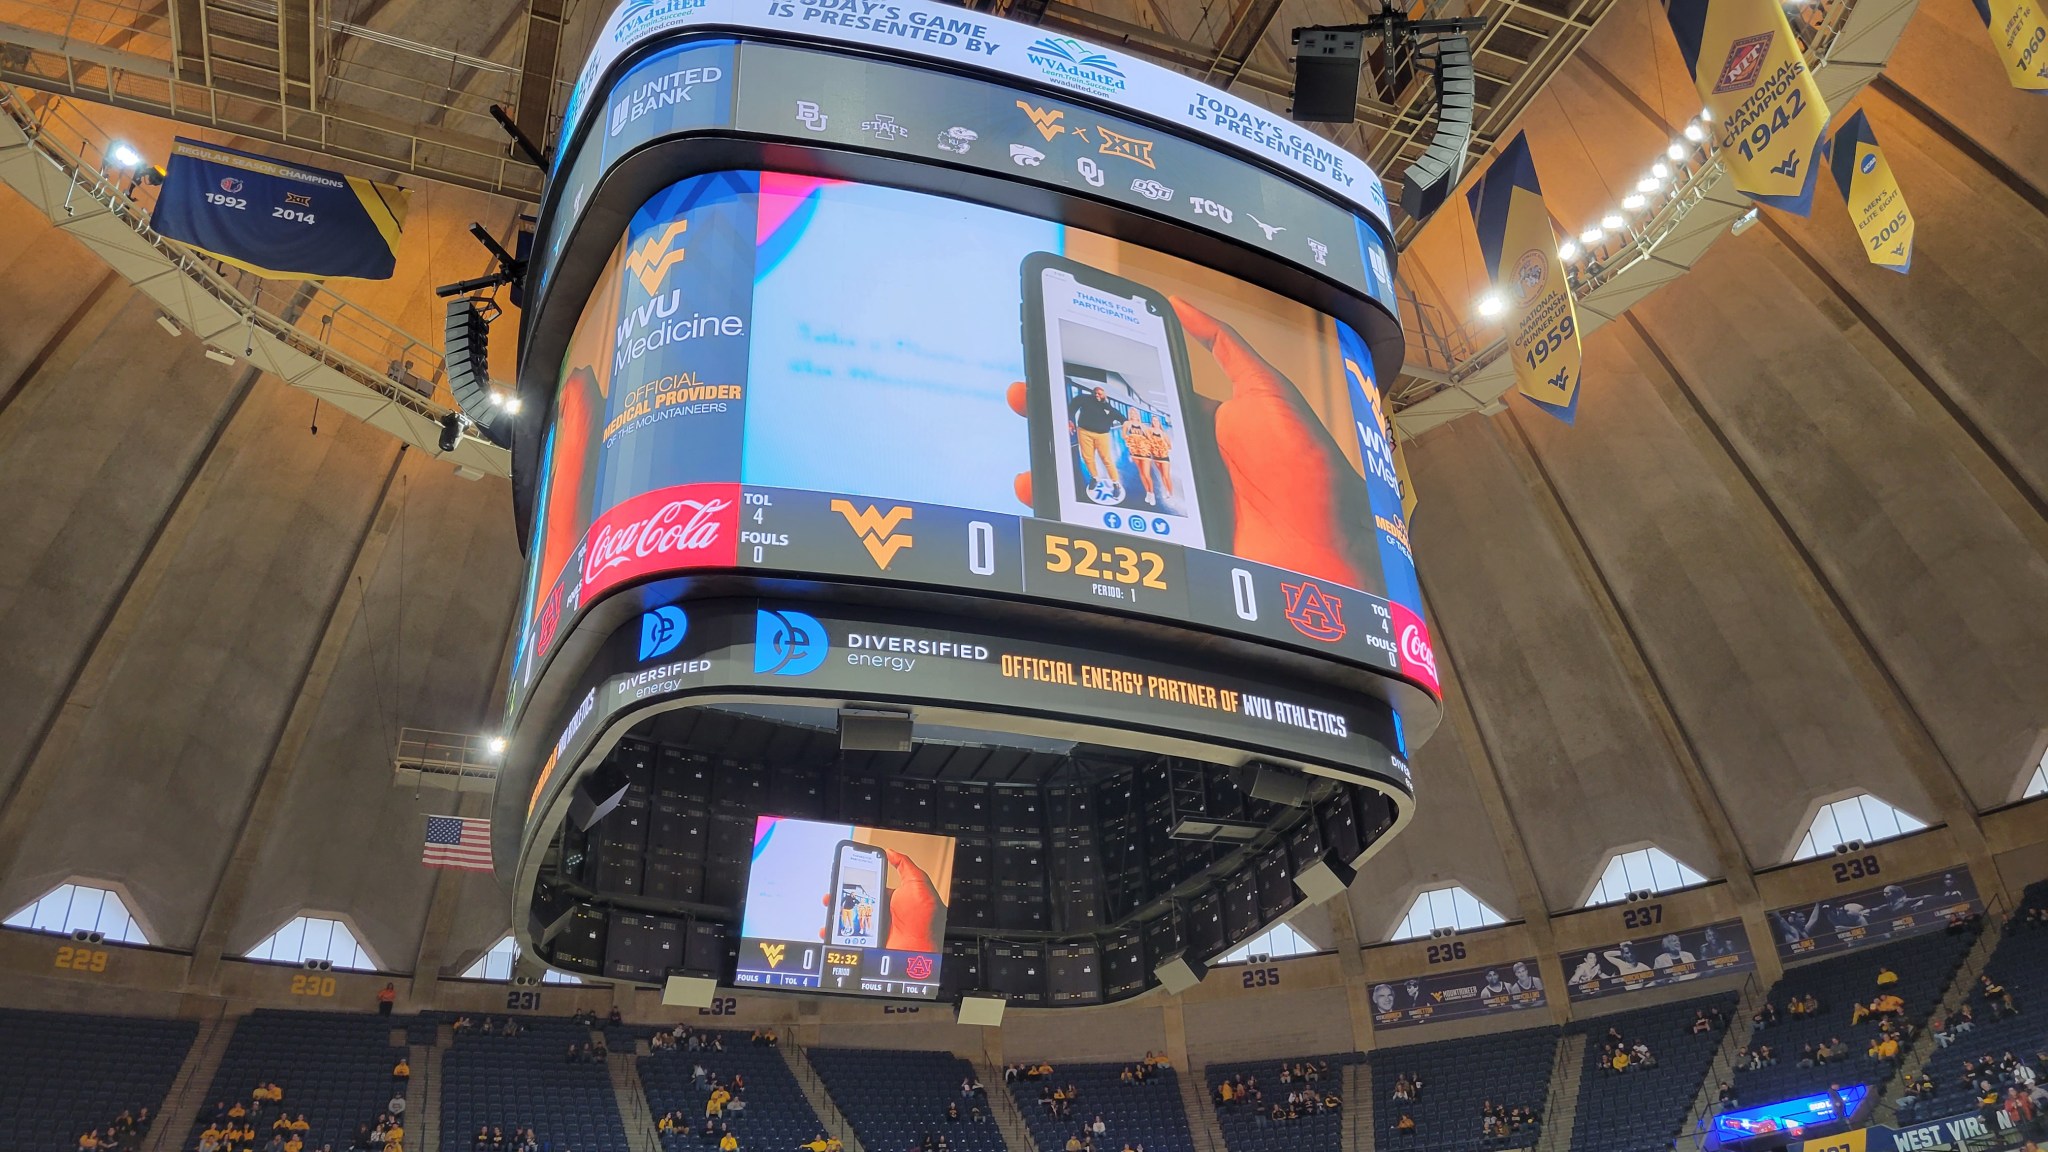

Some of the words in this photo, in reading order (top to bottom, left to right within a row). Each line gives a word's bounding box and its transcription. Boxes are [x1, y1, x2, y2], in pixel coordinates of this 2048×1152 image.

[768, 2, 795, 18] IS
[803, 7, 957, 46] PRESENTED
[966, 39, 999, 56] BY
[908, 12, 987, 39] GAME
[2016, 27, 2046, 71] 1960
[1027, 53, 1125, 90] WVAdultEd
[633, 67, 722, 104] UNITED
[1050, 77, 1109, 98] wvadulted.com
[1724, 60, 1793, 132] NATIONAL
[631, 86, 693, 122] BANK
[1722, 62, 1806, 148] CHAMPIONS
[1196, 93, 1283, 139] TODAY'S
[1290, 135, 1343, 170] GAME
[1737, 89, 1806, 162] 1942
[1188, 104, 1207, 120] IS
[1215, 114, 1325, 172] PRESENTED
[1333, 170, 1354, 187] BY
[177, 145, 229, 163] REGULAR
[233, 155, 276, 173] SEASON
[279, 168, 344, 188] CHAMPIONS
[205, 193, 247, 210] 1992
[1190, 197, 1233, 224] TCU
[1859, 211, 1878, 230] ELITE
[1879, 189, 1898, 212] EIGHT
[1863, 189, 1887, 214] MEN'S
[272, 207, 315, 225] 2014
[1870, 210, 1907, 251] 2005
[1072, 298, 1141, 325] PARTICIPATING
[1076, 291, 1114, 308] THANKS
[1116, 304, 1134, 314] FOR
[1519, 290, 1558, 330] NATIONAL
[617, 288, 681, 347] WVU
[1514, 292, 1568, 347] CHAMPIONSHI
[1523, 305, 1567, 349] RUNNER-UP
[614, 313, 743, 376] Medicine
[1526, 316, 1574, 370] 1959
[624, 371, 704, 408] OFFICIAL
[602, 401, 651, 443] MEDICAL
[655, 385, 742, 409] PROVIDER
[606, 434, 617, 449] OF
[618, 425, 634, 440] THE
[635, 402, 727, 429] MOUNTAINEERS
[744, 493, 772, 507] TOL
[753, 509, 763, 524] 4
[585, 498, 732, 585] Coca-Cola
[741, 531, 788, 546] FOULS
[967, 521, 994, 576] 0
[753, 546, 762, 562] 0
[1044, 534, 1167, 590] 52:32
[1130, 588, 1137, 603] 1
[1231, 568, 1258, 621] 0
[1371, 603, 1391, 619] TOL
[1381, 619, 1389, 634] 4
[848, 633, 988, 662] DIVERSIFIED
[1366, 634, 1398, 653] FOULS
[847, 653, 915, 672] energy
[1389, 652, 1397, 668] 0
[618, 660, 711, 694] DIVERSIFIED
[636, 677, 682, 698] energy
[1001, 655, 1077, 686] OFFICIAL
[1082, 666, 1142, 696] ENERGY
[1147, 676, 1217, 709] PARTNER
[1220, 687, 1239, 713] OF
[1242, 694, 1273, 721] WVU
[1275, 700, 1347, 738] ATHLETICS
[1832, 854, 1881, 883] 238
[1623, 904, 1663, 929] 237
[55, 946, 108, 973] 229
[802, 949, 813, 970] 0
[827, 952, 858, 966] 52:32
[881, 955, 890, 976] 0
[1426, 941, 1467, 964] 236
[737, 974, 758, 982] FOULS
[765, 974, 771, 984] 0
[784, 977, 797, 985] TOL
[802, 977, 808, 986] 4
[832, 967, 850, 976] PERIOD
[837, 977, 842, 987] 1
[1242, 968, 1281, 989] 235
[291, 974, 336, 997] 230
[861, 983, 881, 991] FOULS
[906, 985, 918, 994] TOL
[921, 985, 927, 995] 4
[506, 991, 541, 1012] 231
[1893, 1125, 1942, 1152] WEST
